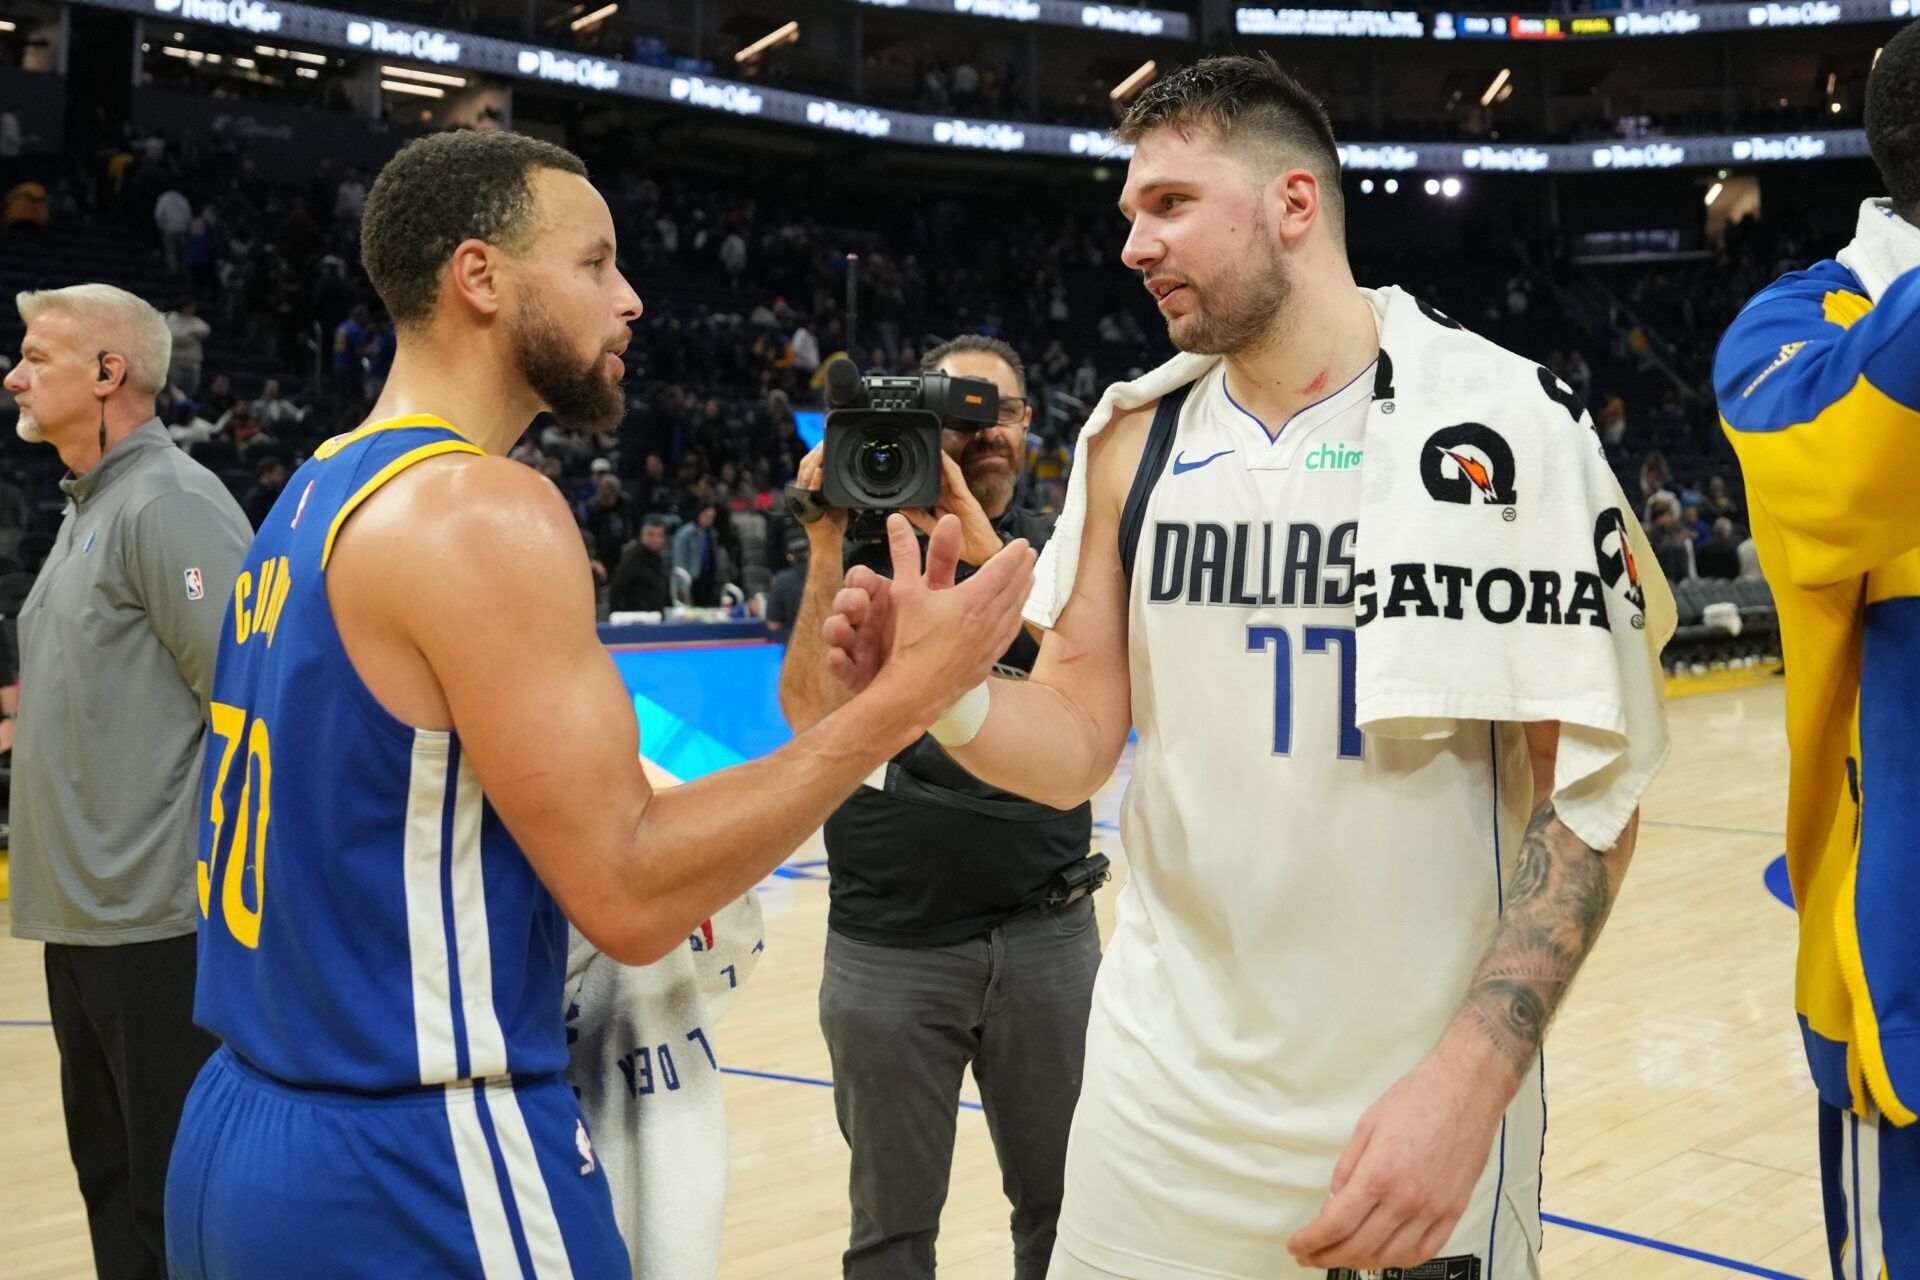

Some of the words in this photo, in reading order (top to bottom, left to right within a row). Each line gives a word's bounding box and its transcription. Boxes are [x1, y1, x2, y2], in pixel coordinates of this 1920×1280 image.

[1148, 519, 1359, 609] DALLAS
[1245, 624, 1366, 761] 77
[197, 701, 272, 949] 30
